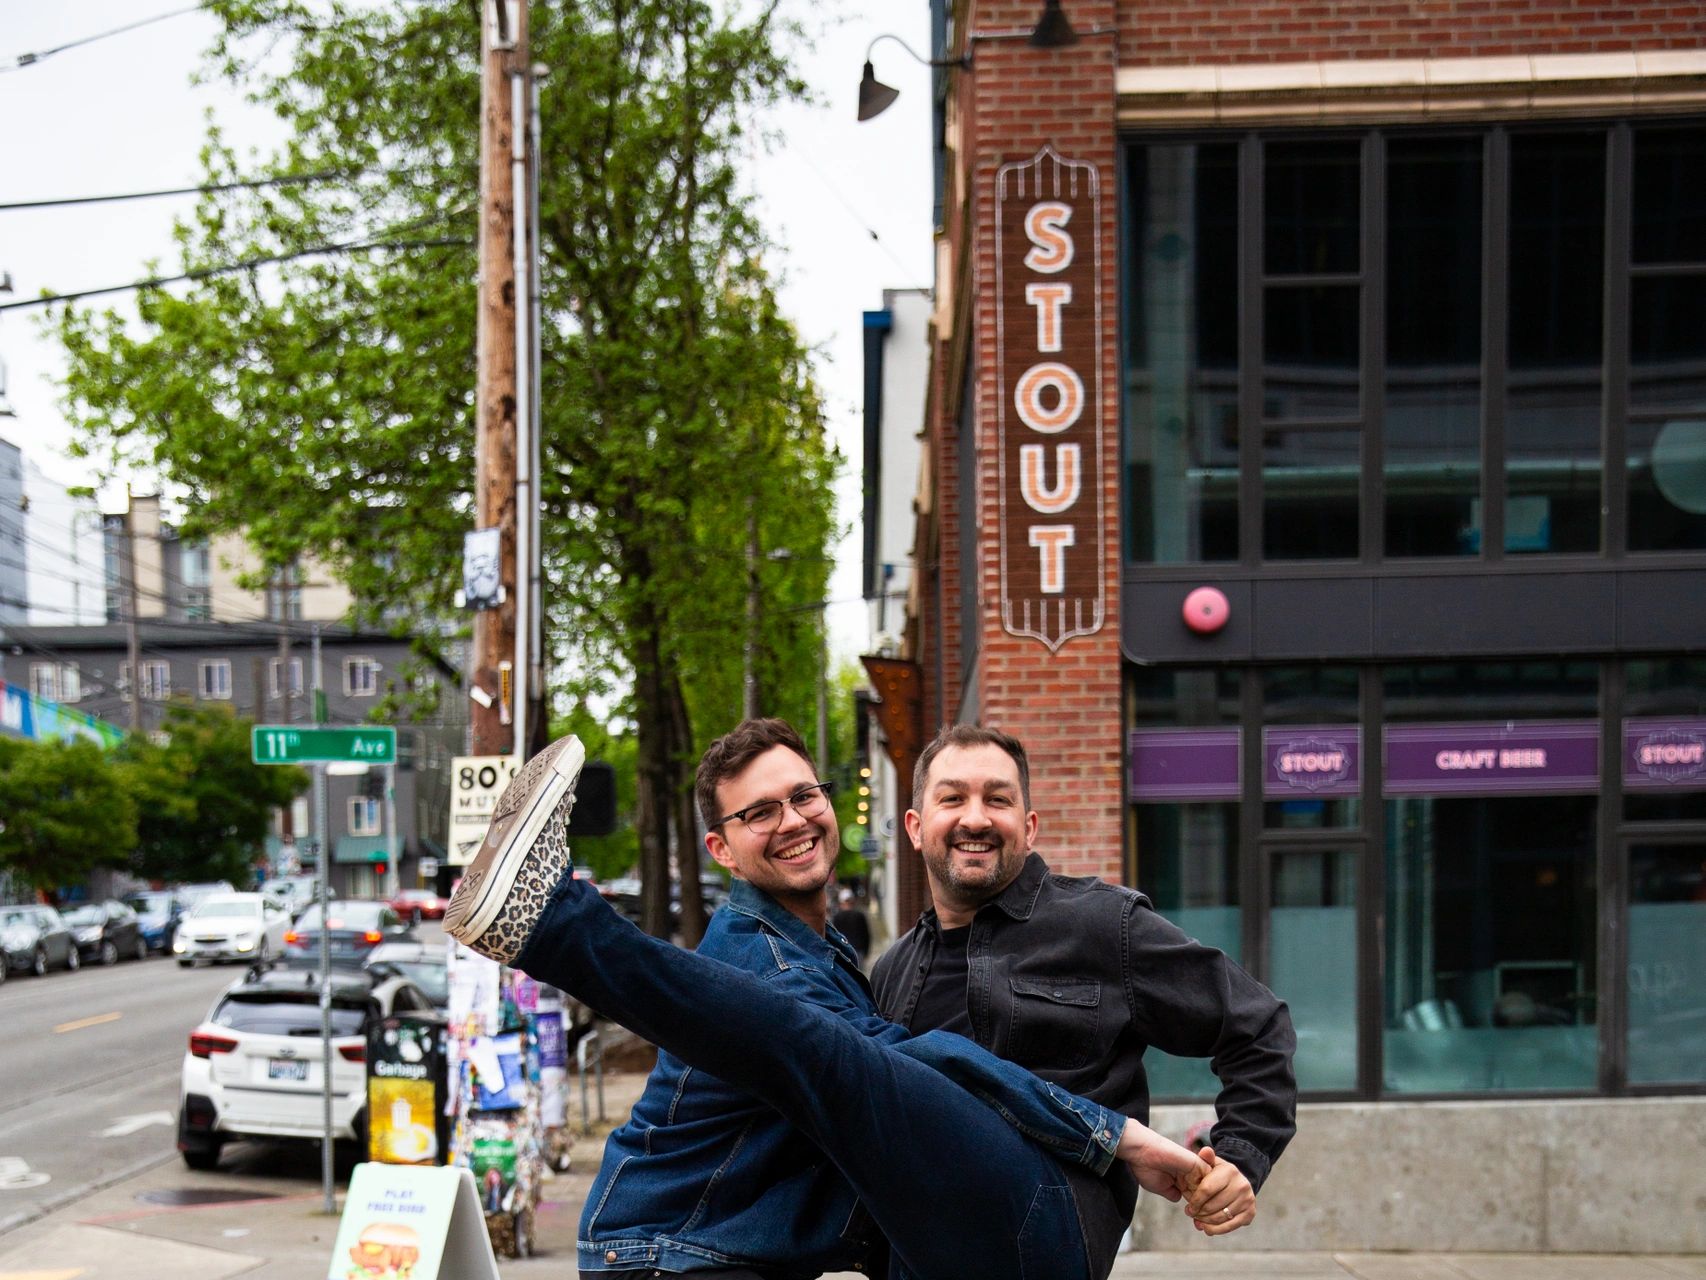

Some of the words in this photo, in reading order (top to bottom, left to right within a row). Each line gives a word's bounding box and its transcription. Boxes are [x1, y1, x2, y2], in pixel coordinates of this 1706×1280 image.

[1014, 201, 1084, 593] STOUT
[351, 737, 386, 756] Ave
[1640, 743, 1703, 765] STOUT
[1280, 751, 1344, 773] STOUT
[1435, 749, 1497, 770] CRAFT
[1499, 748, 1547, 769] BEER
[374, 1060, 427, 1080] Garbage
